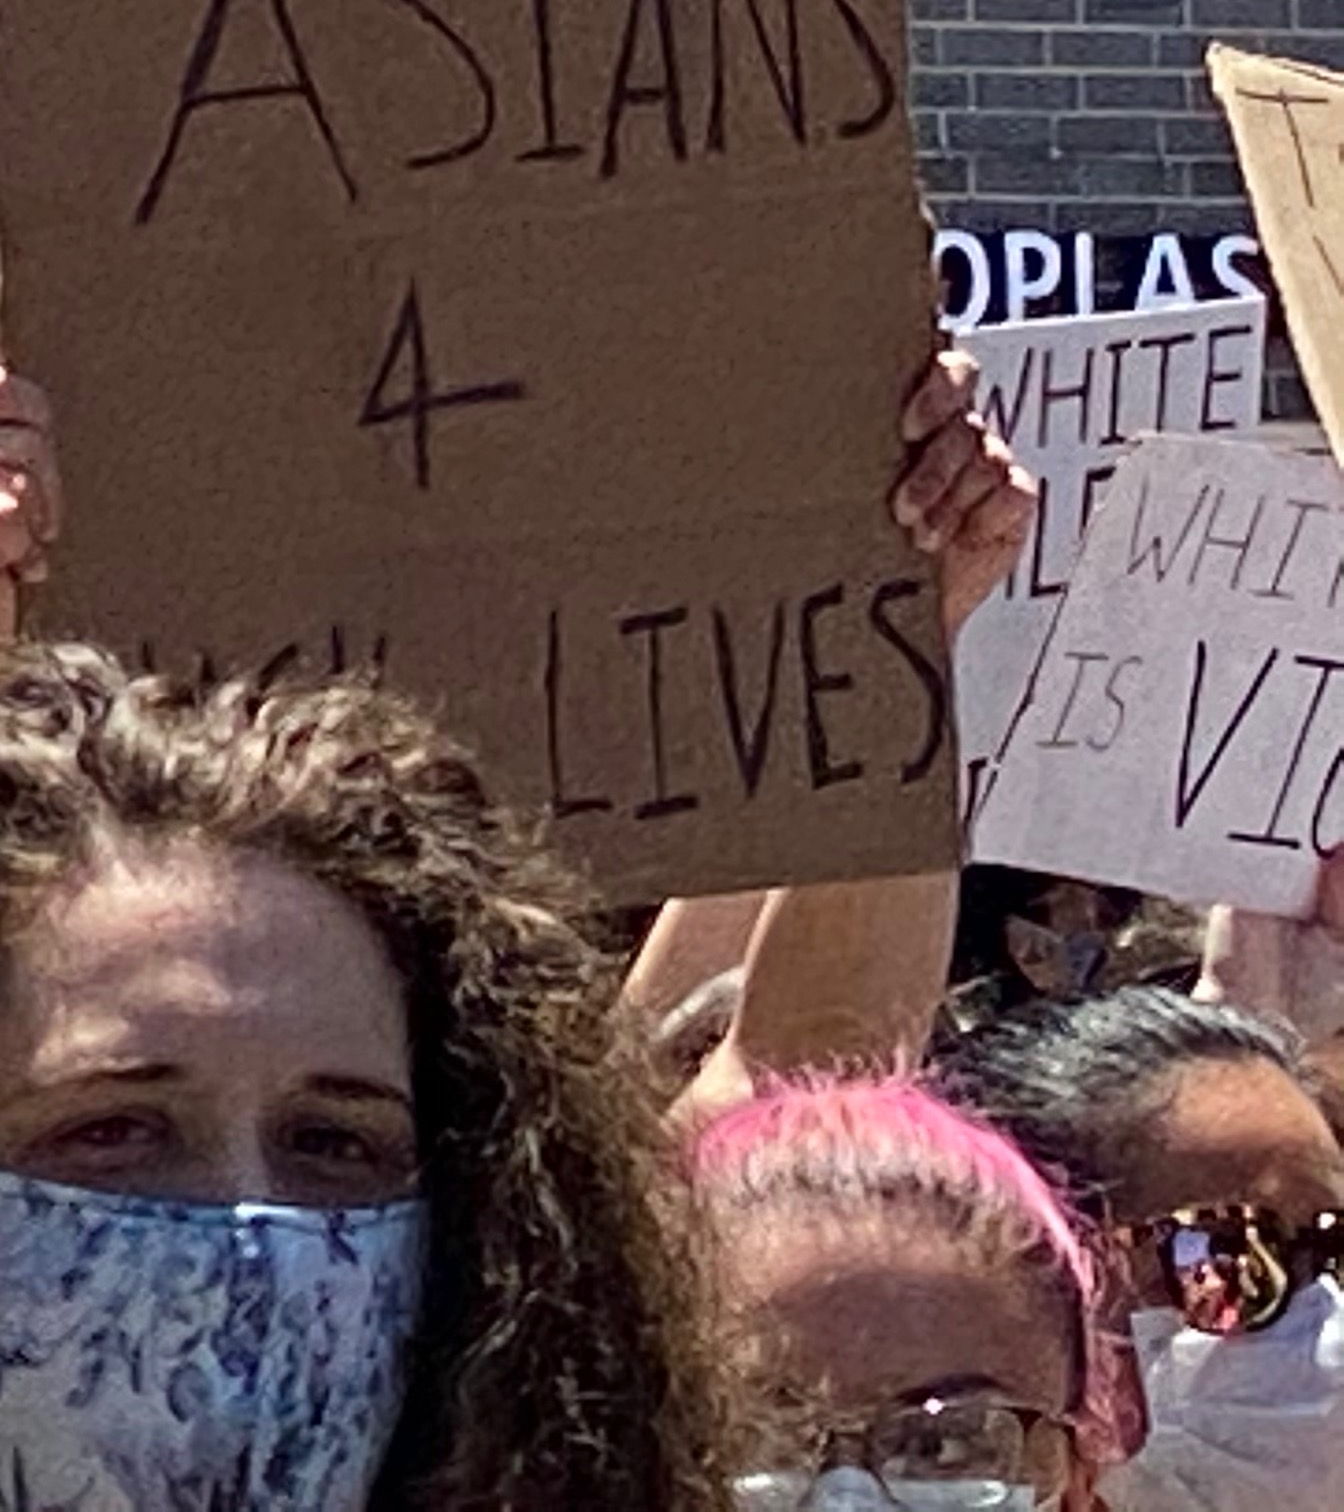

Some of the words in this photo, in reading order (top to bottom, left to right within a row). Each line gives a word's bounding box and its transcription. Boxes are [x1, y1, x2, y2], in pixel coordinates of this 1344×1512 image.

[357, 278, 524, 489] 4
[983, 325, 1252, 448] WHITE
[548, 578, 954, 820] LIVES
[1037, 651, 1144, 752] IS
